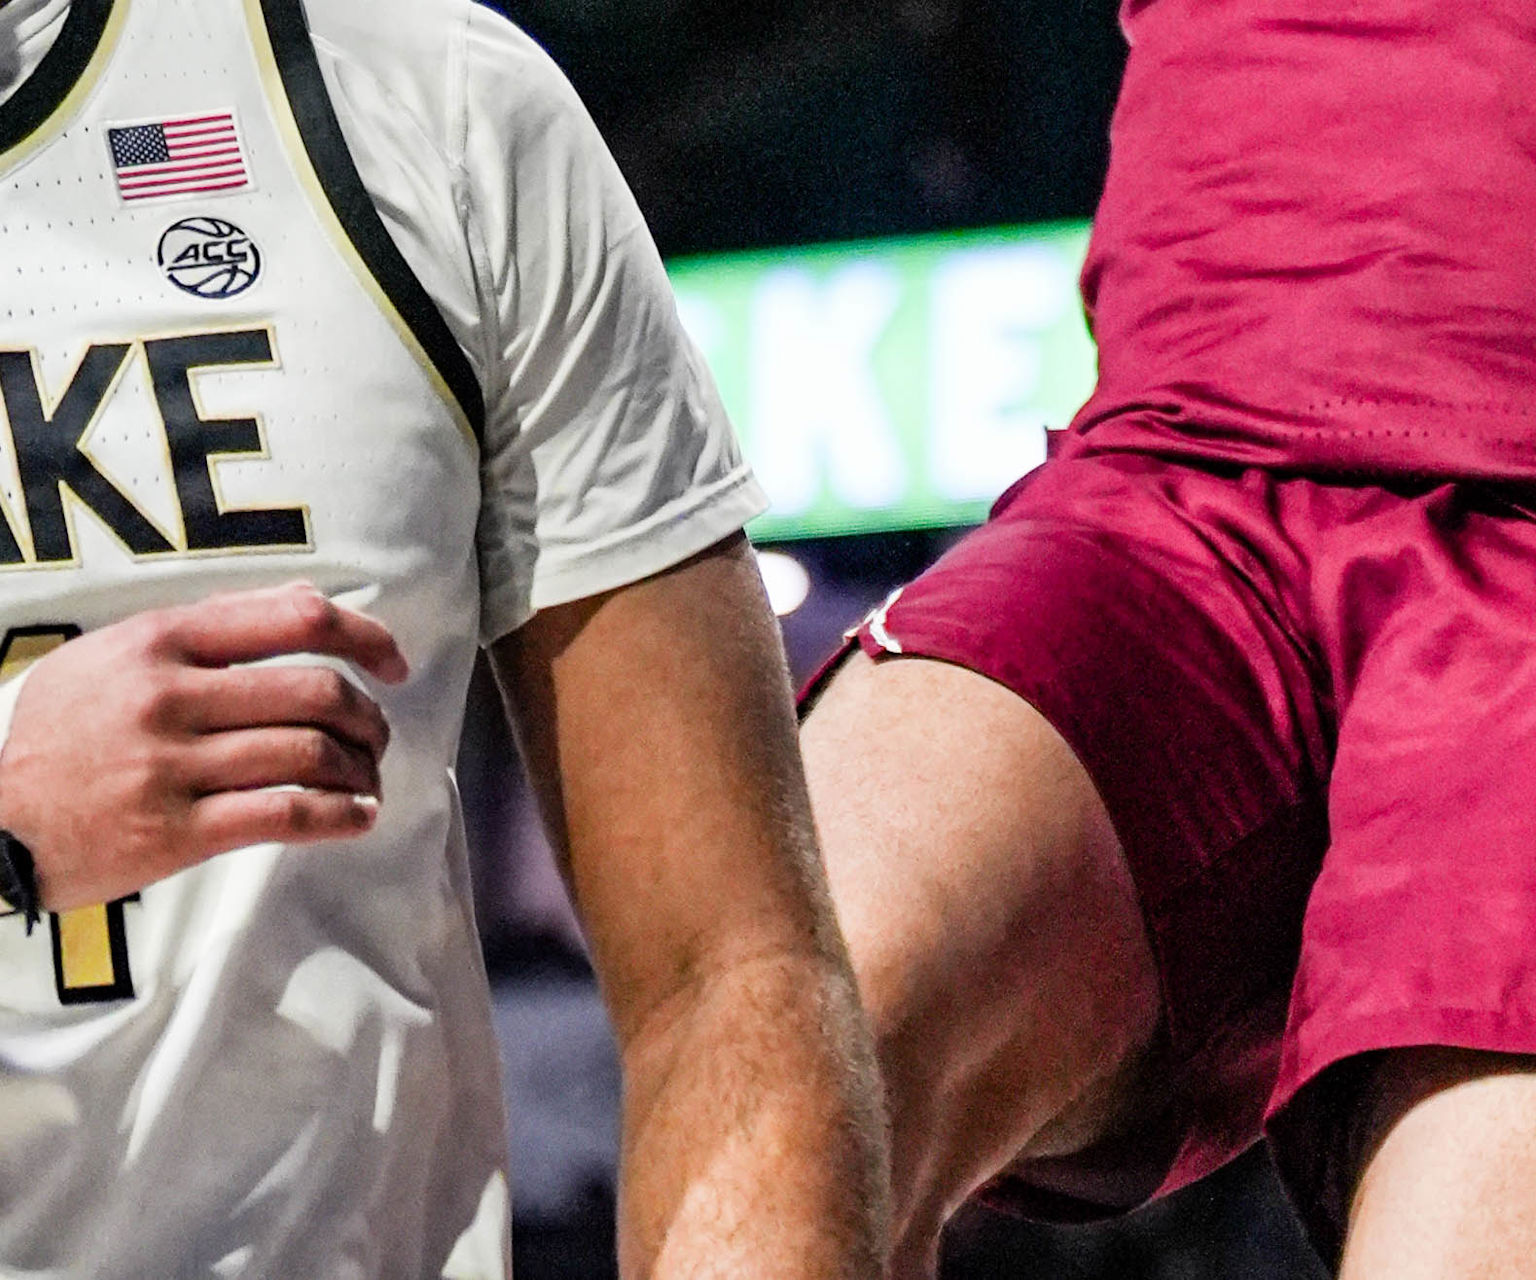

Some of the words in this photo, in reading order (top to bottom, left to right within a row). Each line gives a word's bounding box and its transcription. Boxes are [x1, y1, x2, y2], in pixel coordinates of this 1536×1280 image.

[172, 237, 249, 264] ACC
[0, 322, 316, 574] KE
[680, 246, 1072, 516] KE
